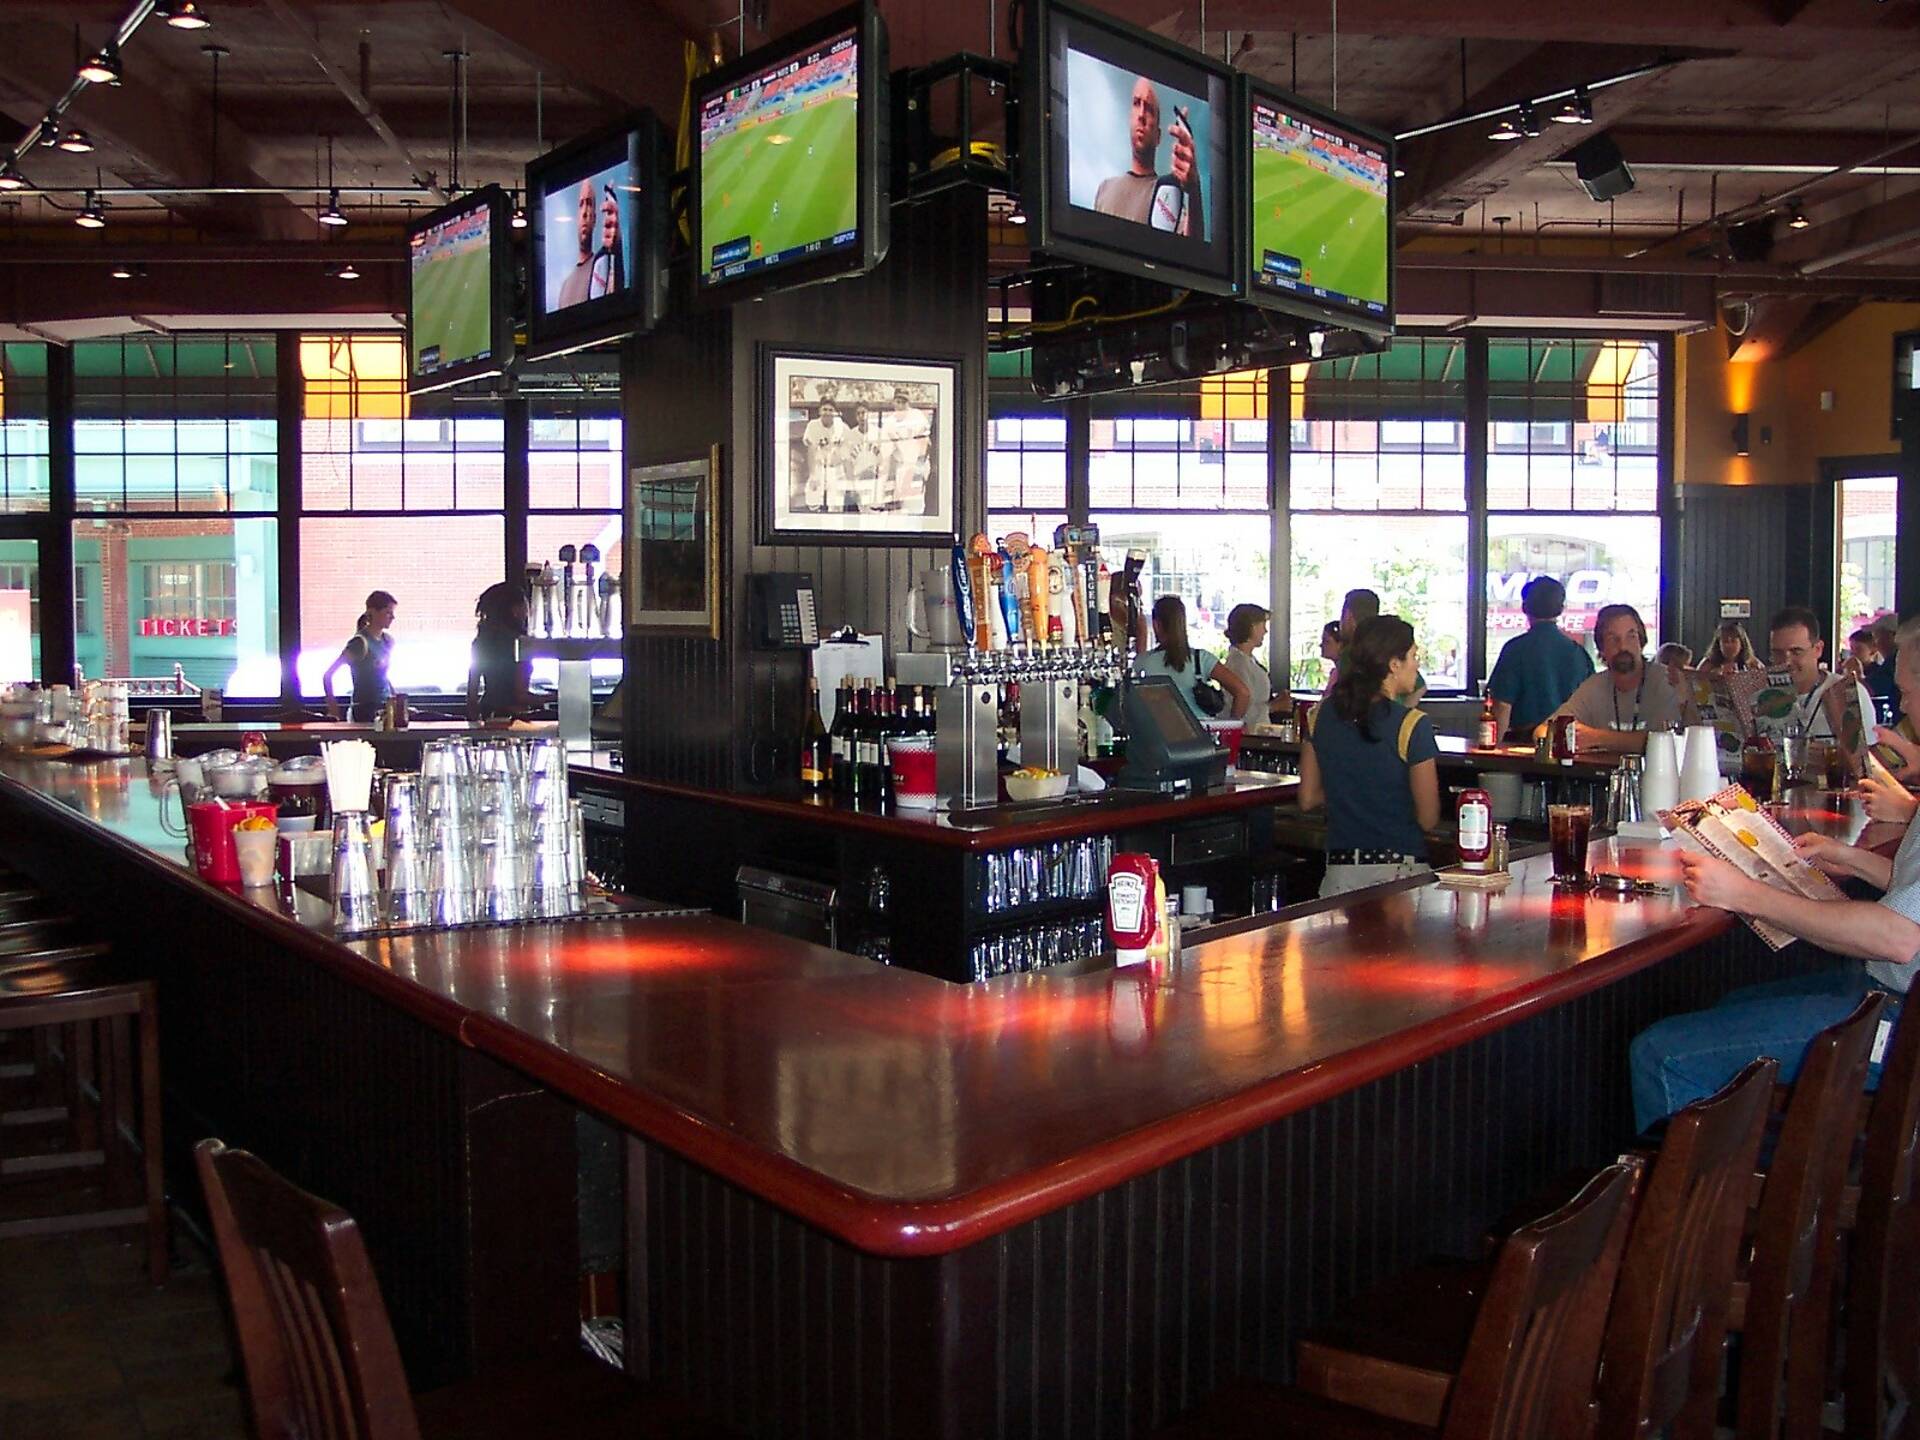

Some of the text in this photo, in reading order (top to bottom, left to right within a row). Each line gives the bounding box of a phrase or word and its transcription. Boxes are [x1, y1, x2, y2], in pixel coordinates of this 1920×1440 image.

[1087, 564, 1096, 609] LAGER
[139, 619, 238, 636] TICKETS
[1487, 614, 1529, 630] SPOR
